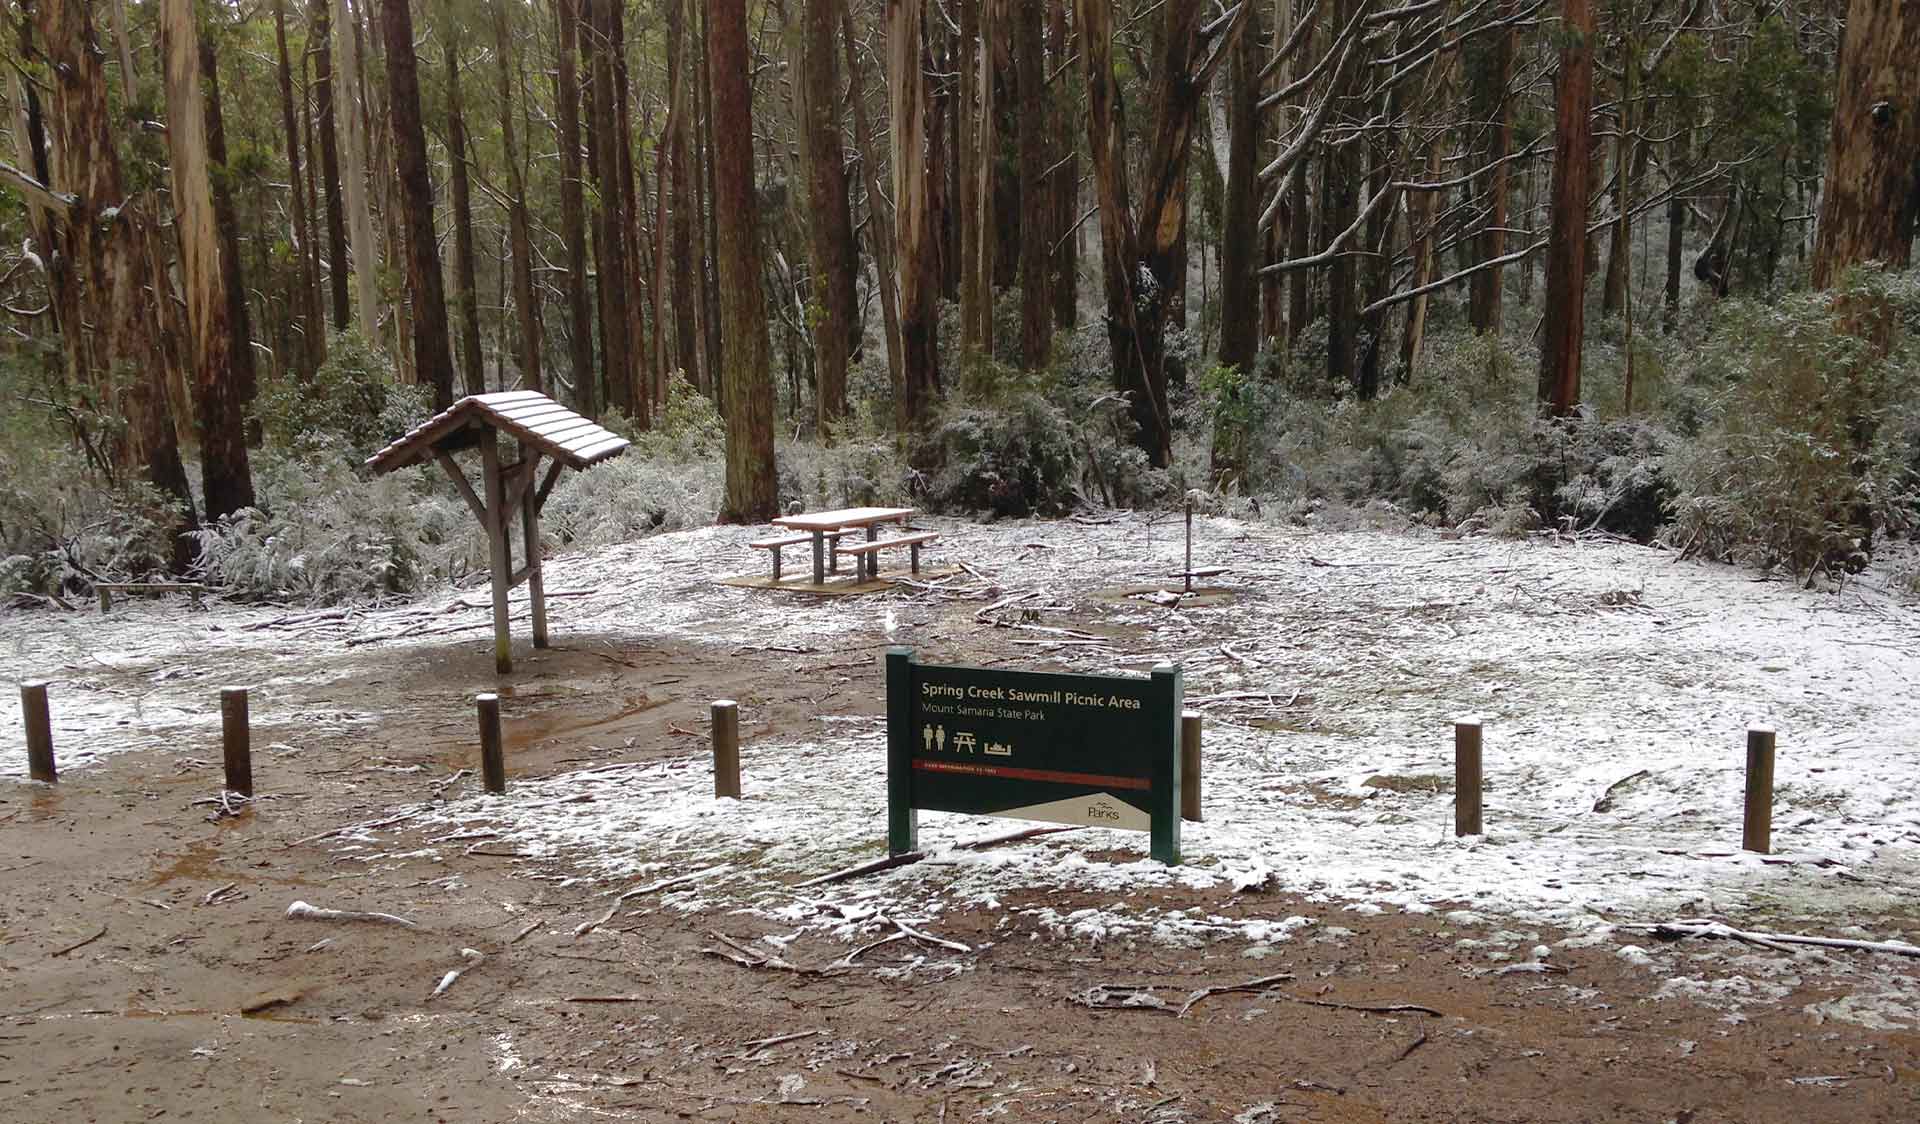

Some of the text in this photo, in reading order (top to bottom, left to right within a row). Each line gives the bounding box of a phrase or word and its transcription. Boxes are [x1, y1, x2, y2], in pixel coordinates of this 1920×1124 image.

[922, 682, 1141, 709] Spring Creek Sawmill Picnic Area
[922, 703, 954, 713] Mount
[997, 708, 1022, 719] State
[1024, 710, 1045, 721] Park
